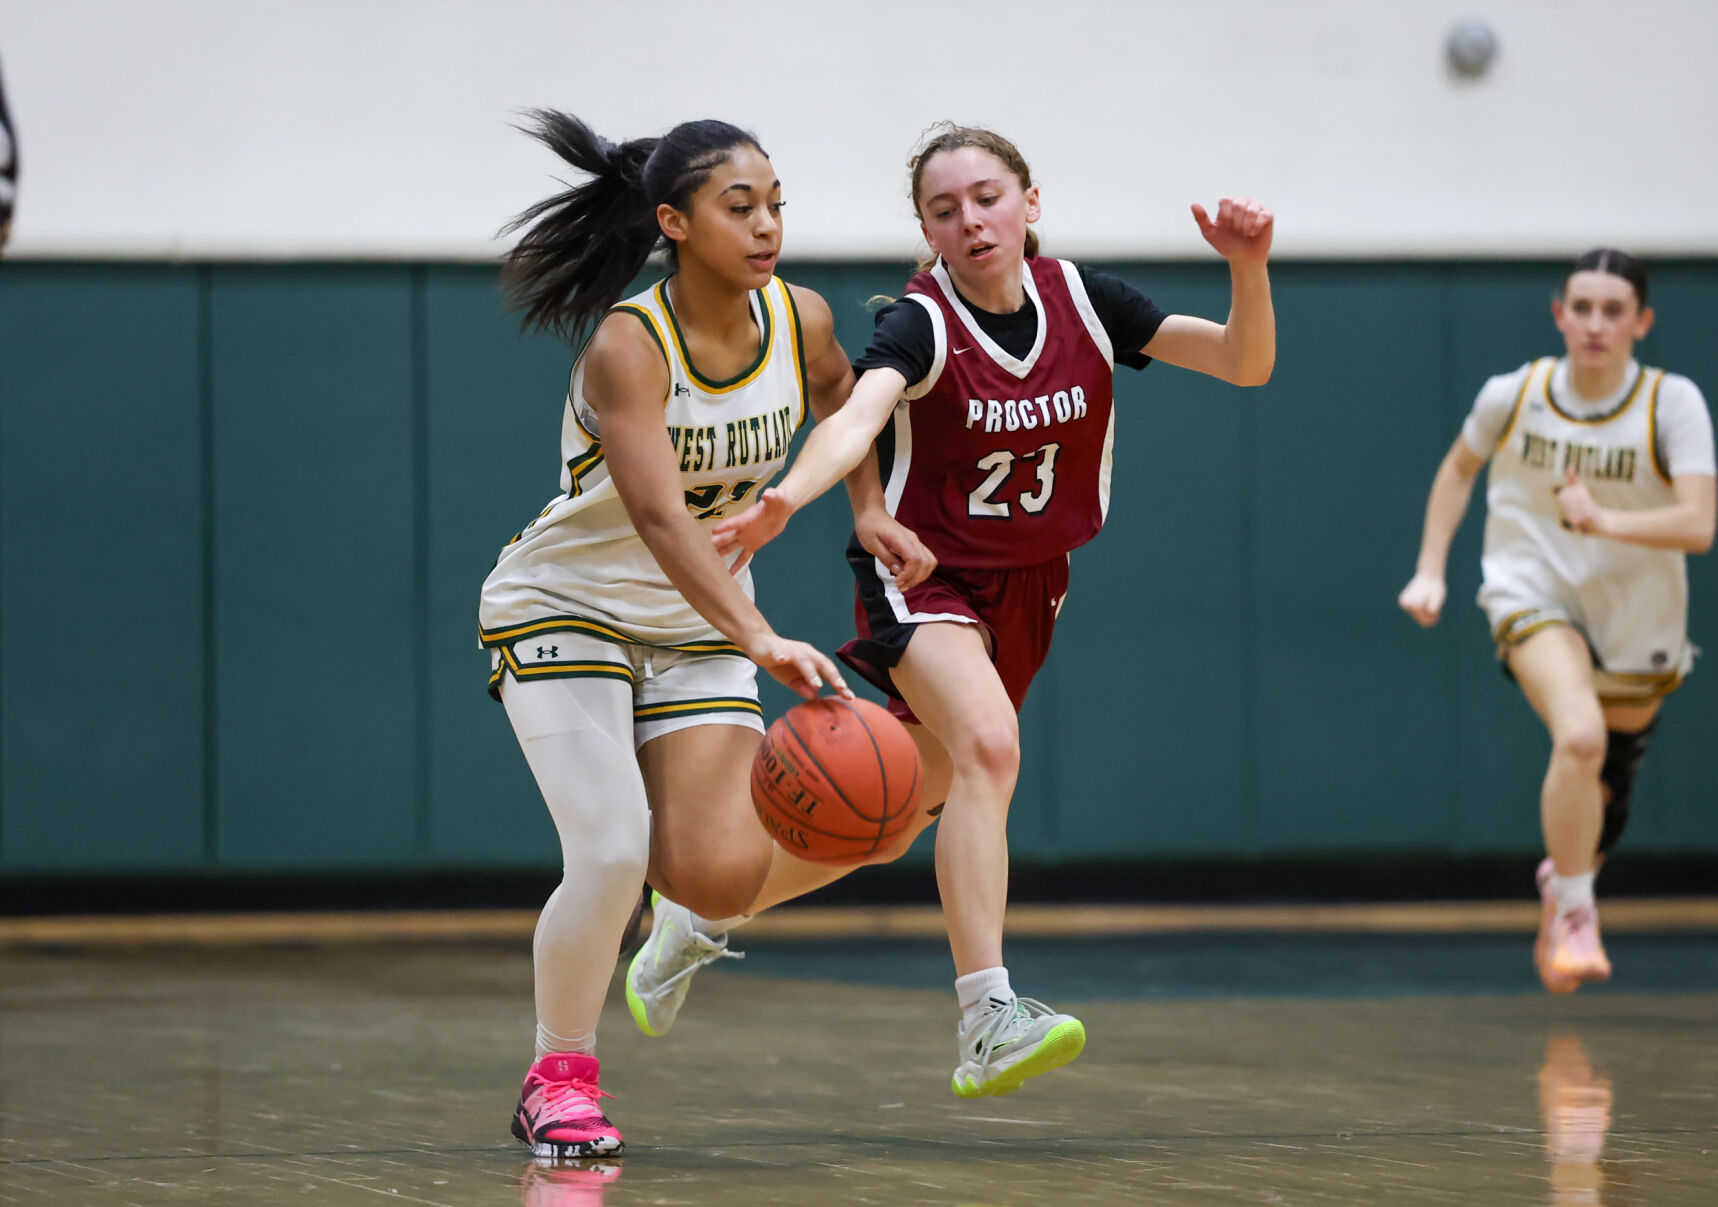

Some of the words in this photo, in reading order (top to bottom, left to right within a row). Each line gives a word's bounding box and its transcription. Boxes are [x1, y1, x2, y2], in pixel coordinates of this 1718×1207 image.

[725, 406, 793, 468] RUTLAN
[965, 385, 1088, 433] PROCTOR
[967, 442, 1062, 521] 23
